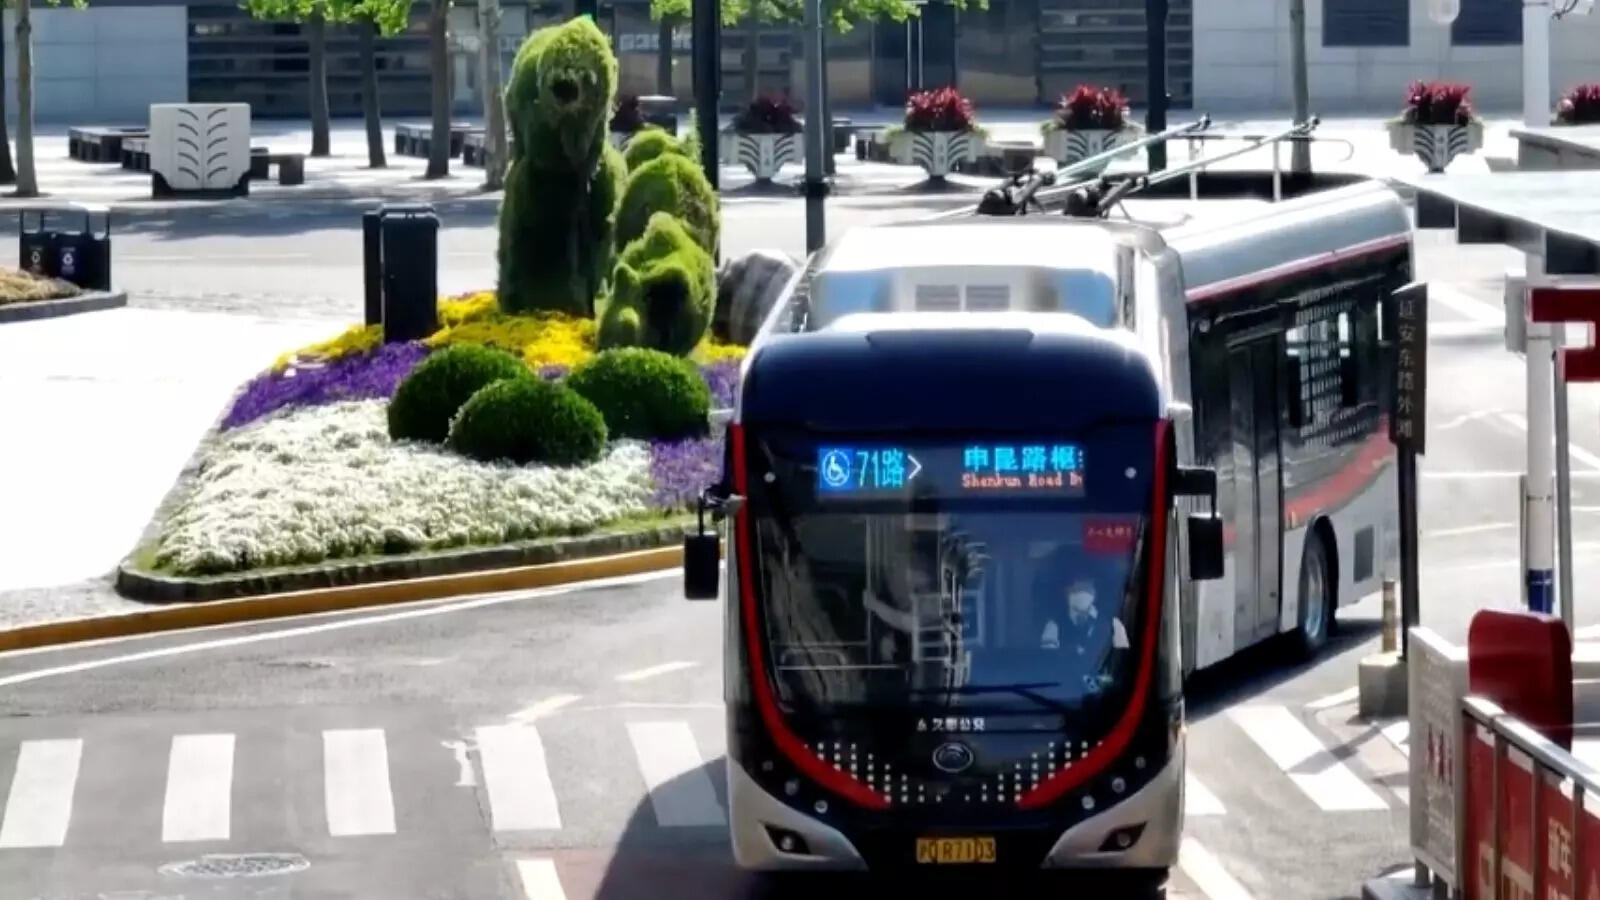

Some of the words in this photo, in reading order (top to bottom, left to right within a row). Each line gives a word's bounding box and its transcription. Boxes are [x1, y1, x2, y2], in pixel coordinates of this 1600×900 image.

[857, 449, 905, 488] 71路
[963, 446, 1083, 472] 申昆路枢
[1028, 473, 1062, 488] Road
